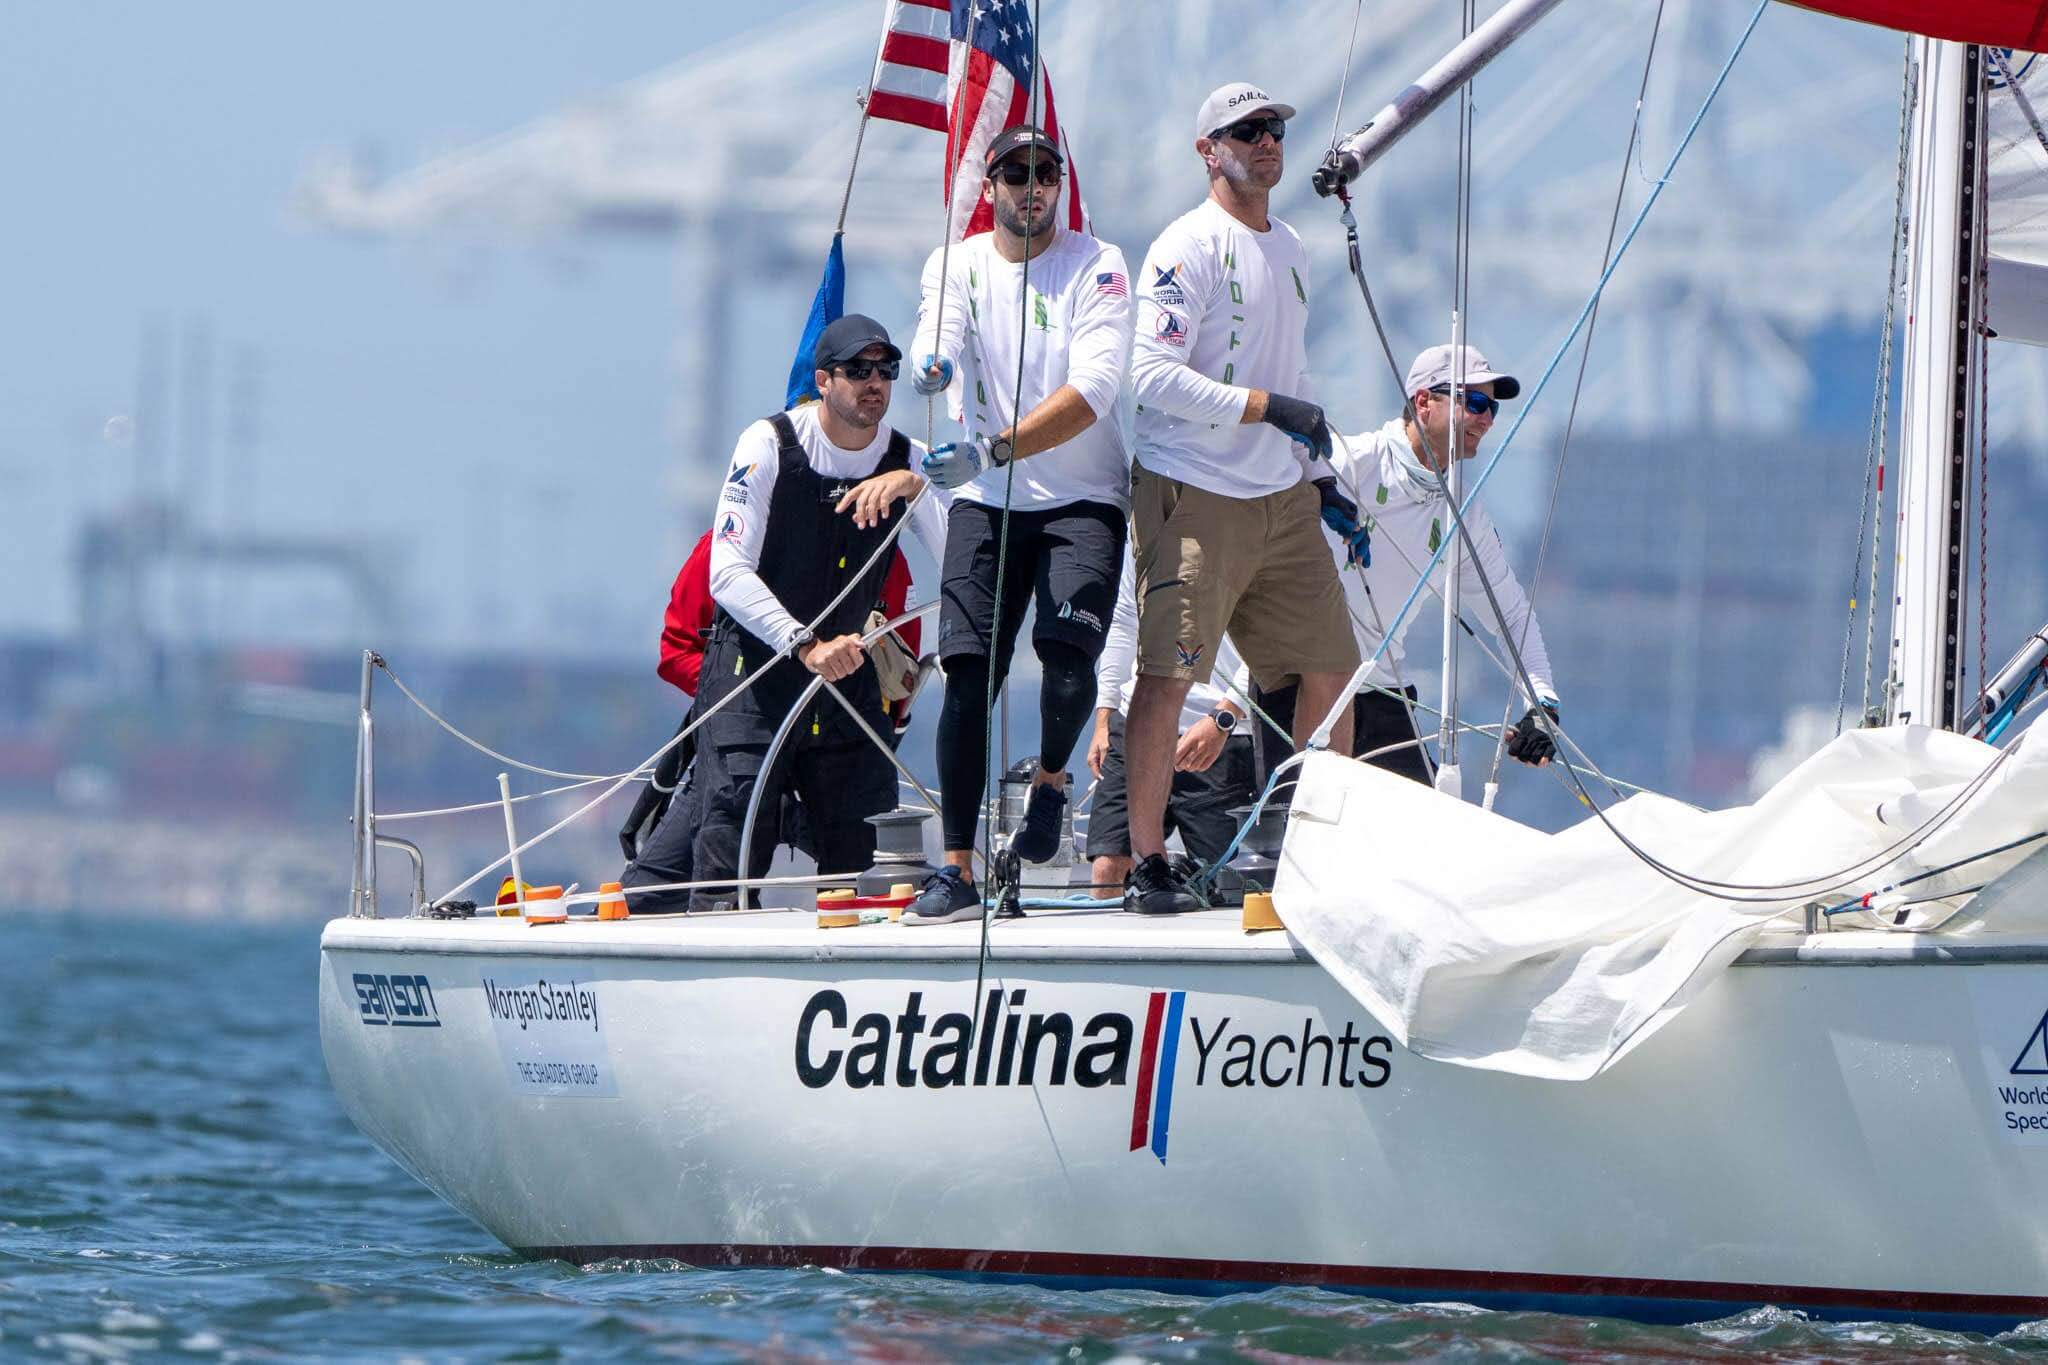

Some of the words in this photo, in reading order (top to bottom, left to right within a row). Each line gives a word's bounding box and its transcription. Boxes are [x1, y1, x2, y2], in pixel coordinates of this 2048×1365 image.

[724, 494, 747, 506] TOUR
[483, 979, 543, 1031] Morgan
[538, 980, 598, 1032] Stanley
[796, 989, 1133, 1088] Catalina
[1190, 1017, 1393, 1088] Yachts
[517, 1062, 536, 1082] THE
[534, 1063, 572, 1084] SHADDEN
[571, 1063, 598, 1086] GROUP
[2006, 1111, 2048, 1134] Spec
